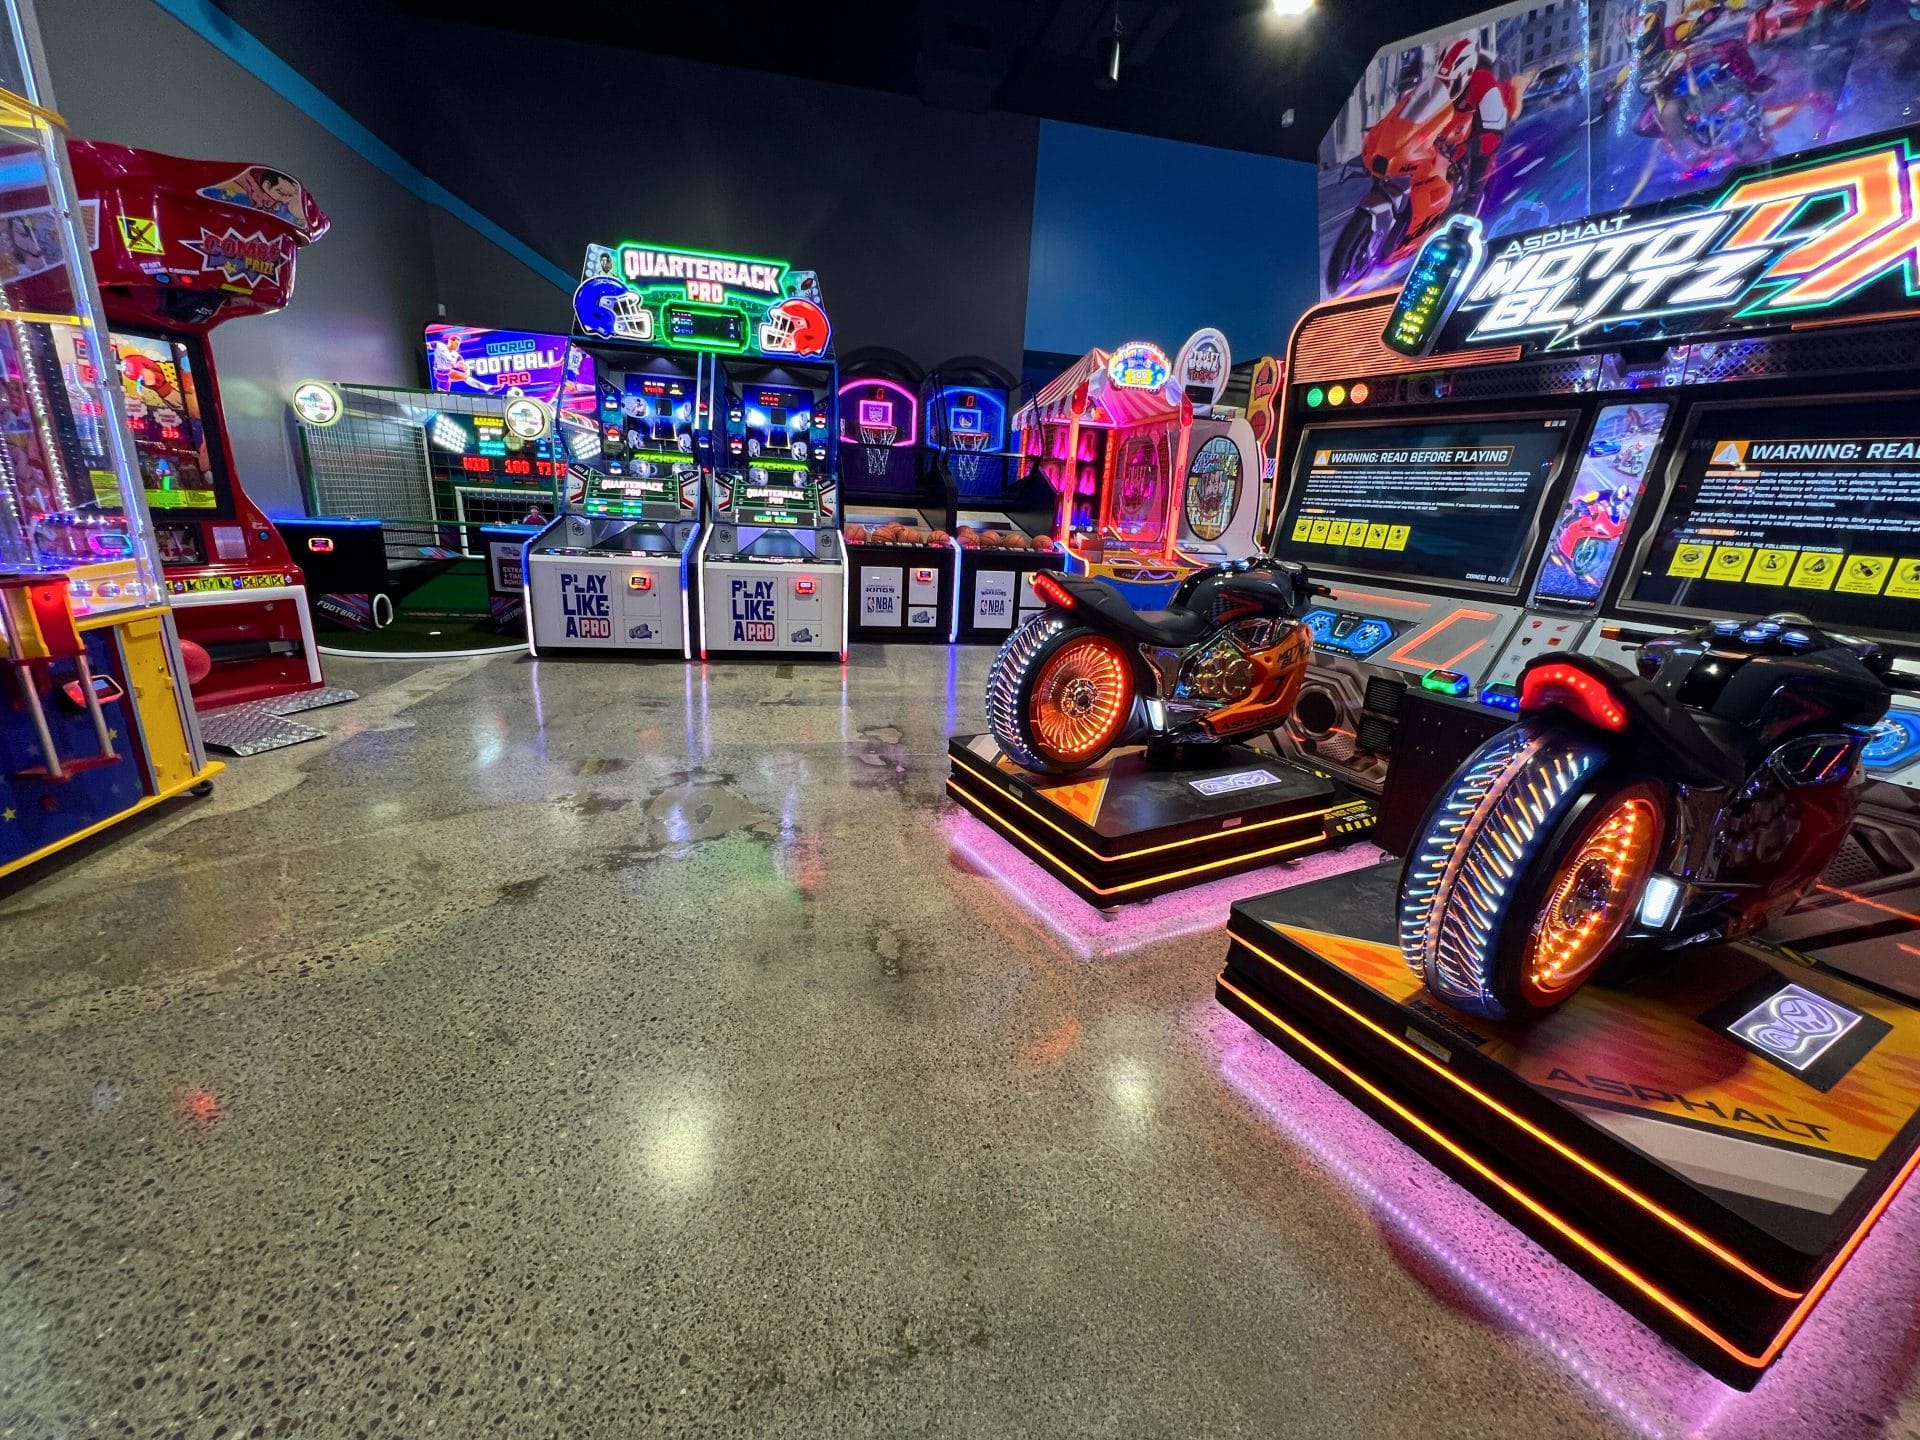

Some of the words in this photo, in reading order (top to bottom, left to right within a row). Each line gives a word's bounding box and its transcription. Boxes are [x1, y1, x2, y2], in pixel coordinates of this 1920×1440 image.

[1504, 215, 1631, 255] ASPHALT
[203, 235, 280, 262] COMBO
[1470, 212, 1731, 300] MOTO
[245, 257, 274, 274] PRIZE
[624, 250, 779, 294] QUARTERBACK
[687, 280, 723, 303] PRO
[1477, 248, 1772, 332] BLITZ
[487, 339, 535, 354] WORLD
[466, 351, 554, 376] FOOTBALL
[497, 372, 530, 386] PRO
[1331, 452, 1378, 464] WARNING:
[1380, 451, 1407, 463] READ
[1410, 451, 1452, 462] BEFORE
[1456, 450, 1508, 462] PLAYING
[1752, 443, 1861, 460] WARNING:
[505, 460, 530, 474] 100
[601, 480, 664, 492] QUARTERBACK
[746, 488, 804, 500] QUARTERBACK
[561, 574, 605, 593] PLAY
[731, 580, 774, 599] PLAY
[316, 600, 361, 622] FOOTBALL
[562, 595, 609, 616] LIKE
[732, 600, 774, 620] LIKE
[875, 597, 893, 610] NBA
[988, 600, 1005, 612] NBA
[566, 618, 578, 638] A
[580, 617, 611, 638] PRO
[733, 622, 745, 641] A
[746, 621, 775, 642] PRO
[1547, 1068, 1830, 1142] ASPHALT
